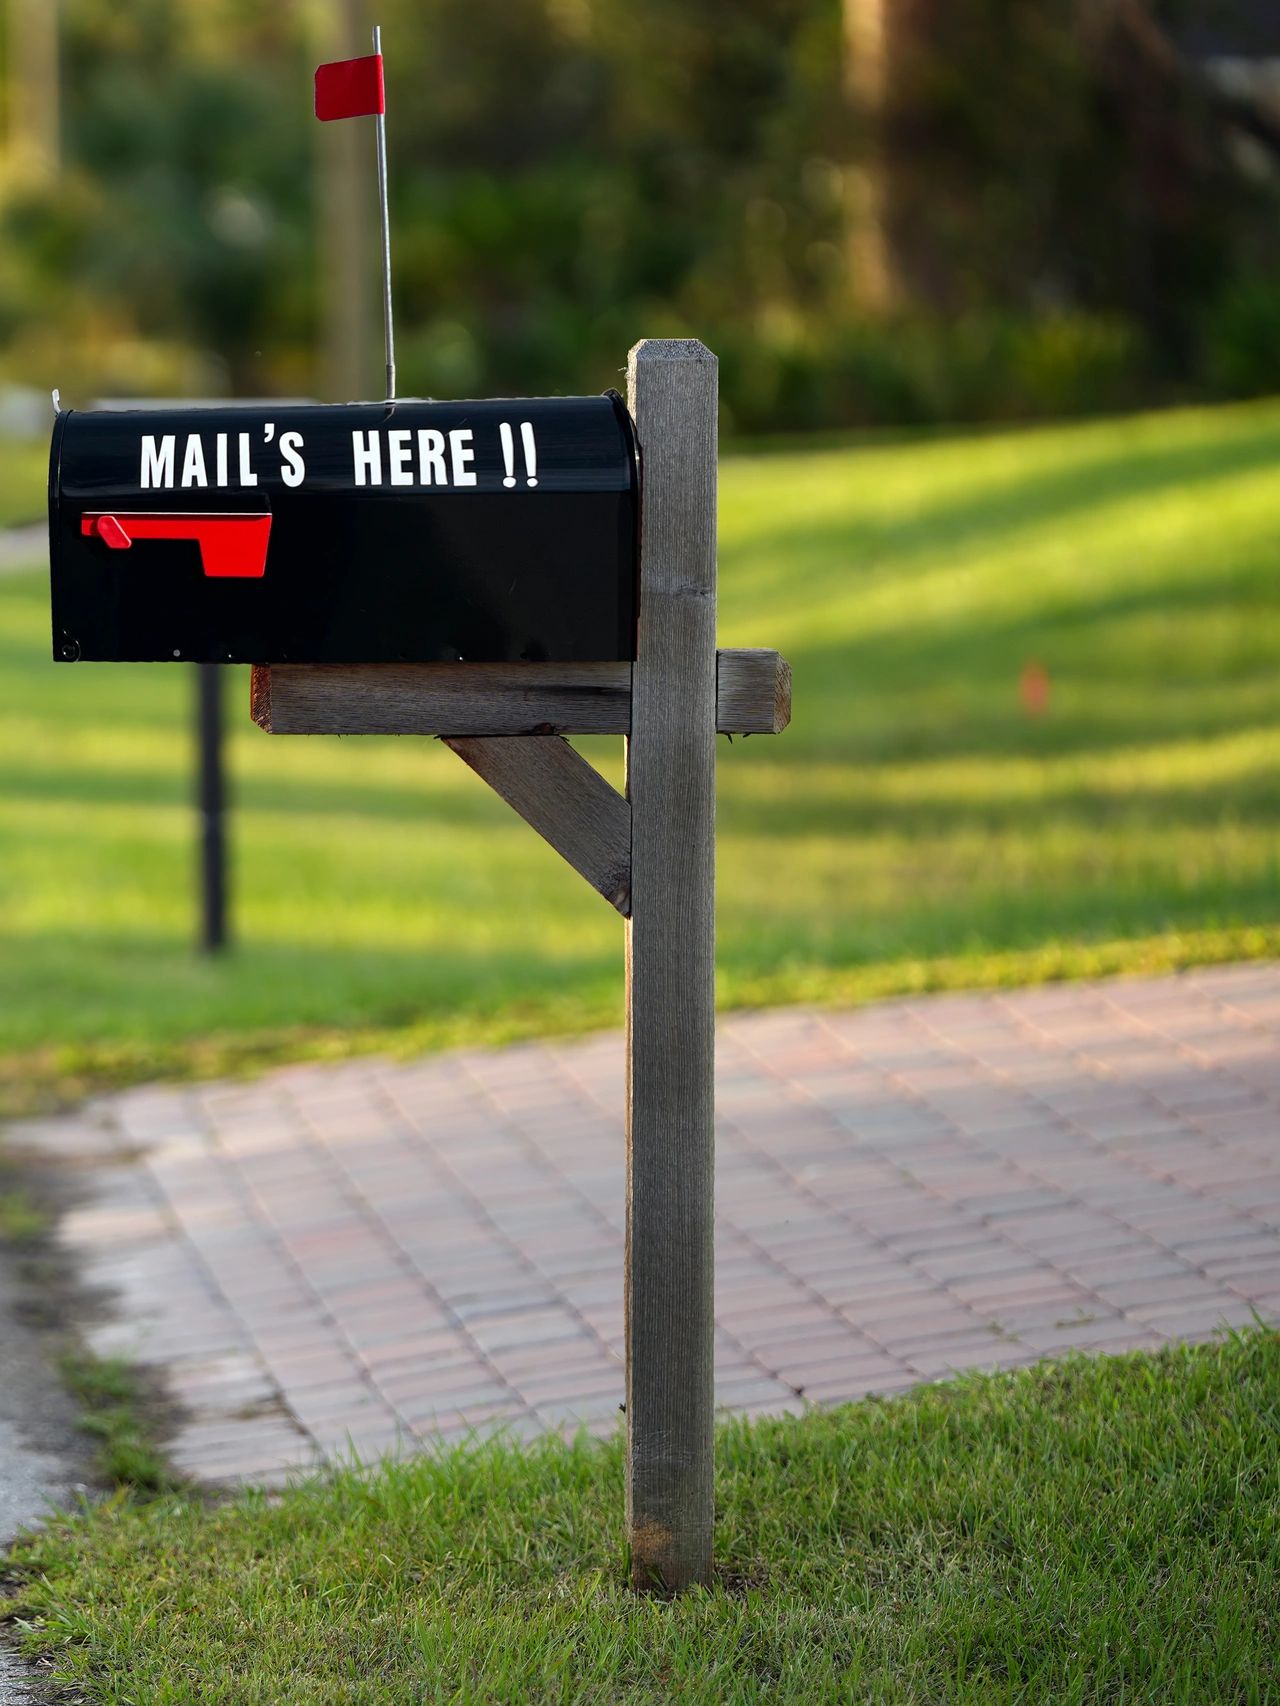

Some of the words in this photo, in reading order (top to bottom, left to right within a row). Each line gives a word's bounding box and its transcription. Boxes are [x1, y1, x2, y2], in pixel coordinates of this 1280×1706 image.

[140, 423, 306, 489] MAIL'S
[352, 429, 477, 486] HERE
[500, 421, 539, 488] !!
